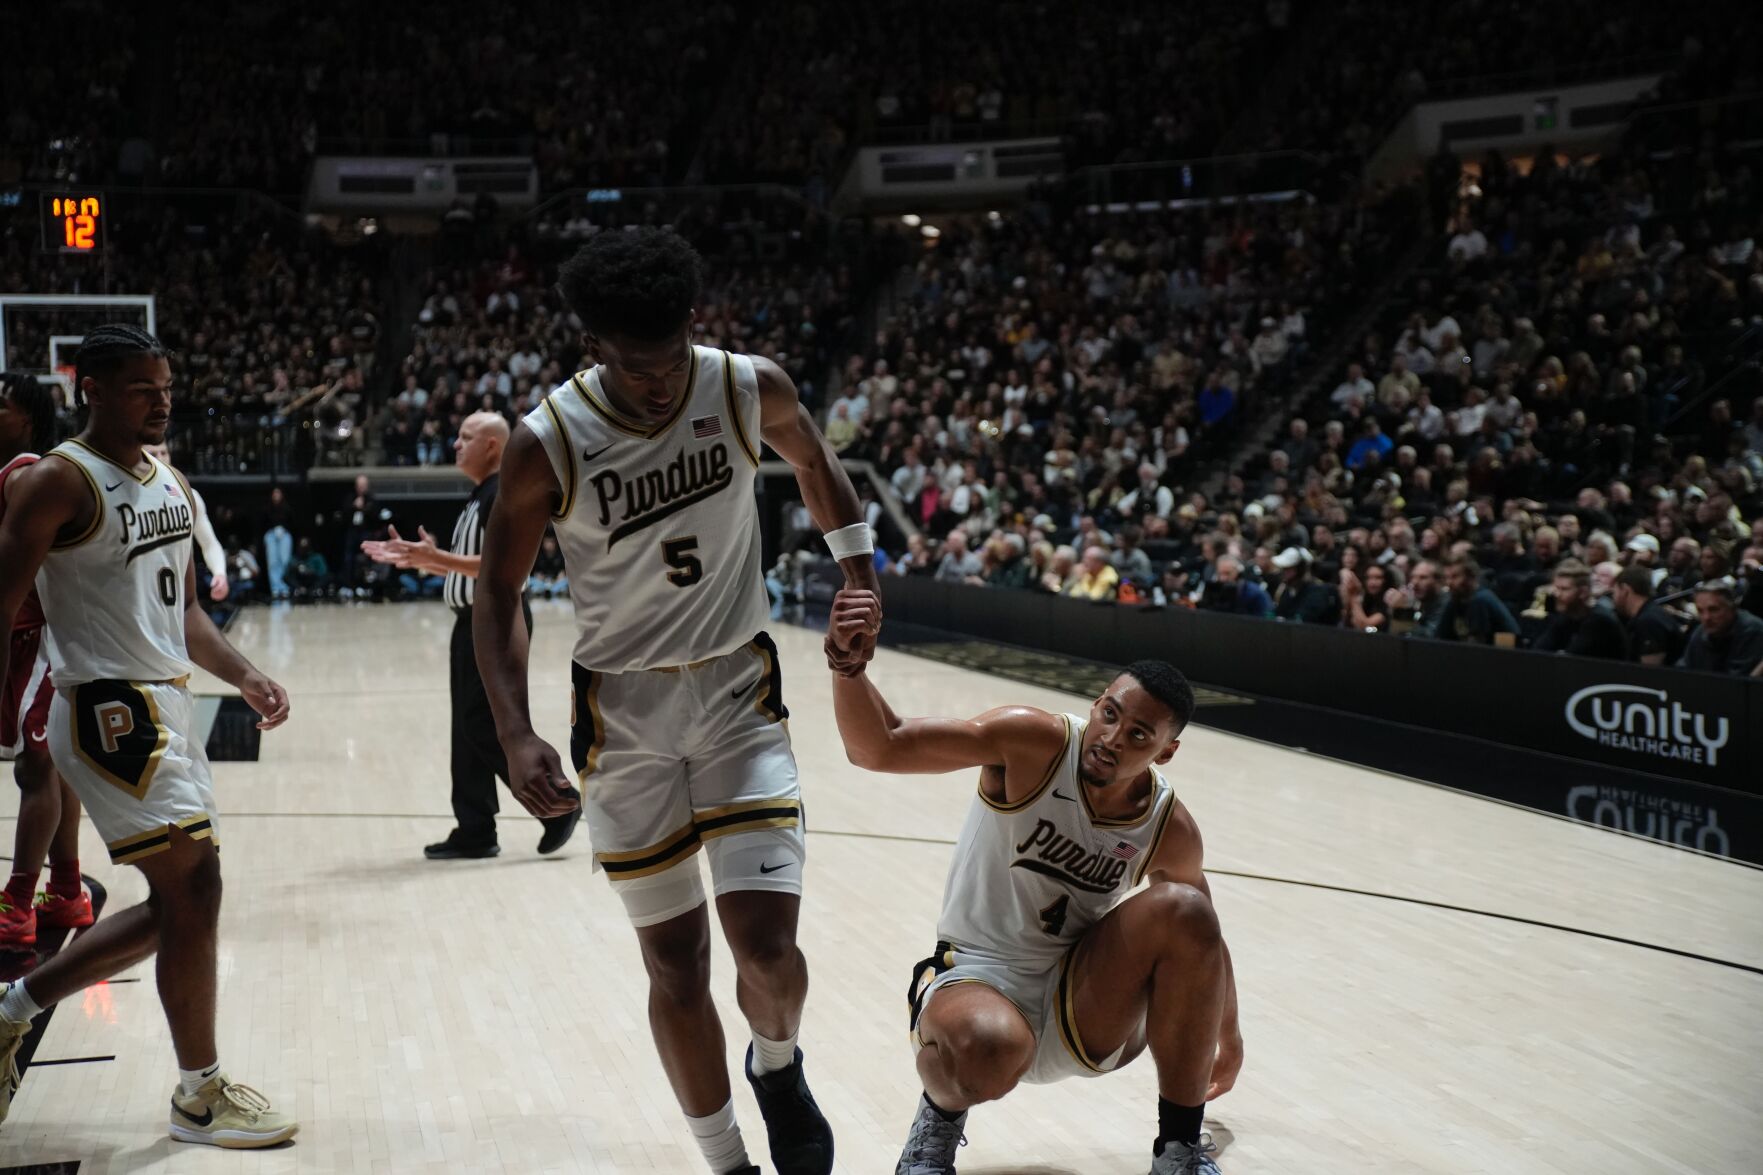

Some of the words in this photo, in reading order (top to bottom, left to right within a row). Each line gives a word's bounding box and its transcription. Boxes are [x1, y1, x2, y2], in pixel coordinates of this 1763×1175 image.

[65, 215, 95, 249] 12
[589, 443, 734, 526] Purdue
[115, 501, 192, 544] Purdue
[661, 535, 703, 587] 5
[159, 567, 176, 606] 0
[93, 700, 135, 753] P
[1590, 688, 1730, 767] unity
[1600, 730, 1704, 763] HEALTHCARE
[1016, 817, 1128, 887] Purdue
[1040, 894, 1070, 936] 4
